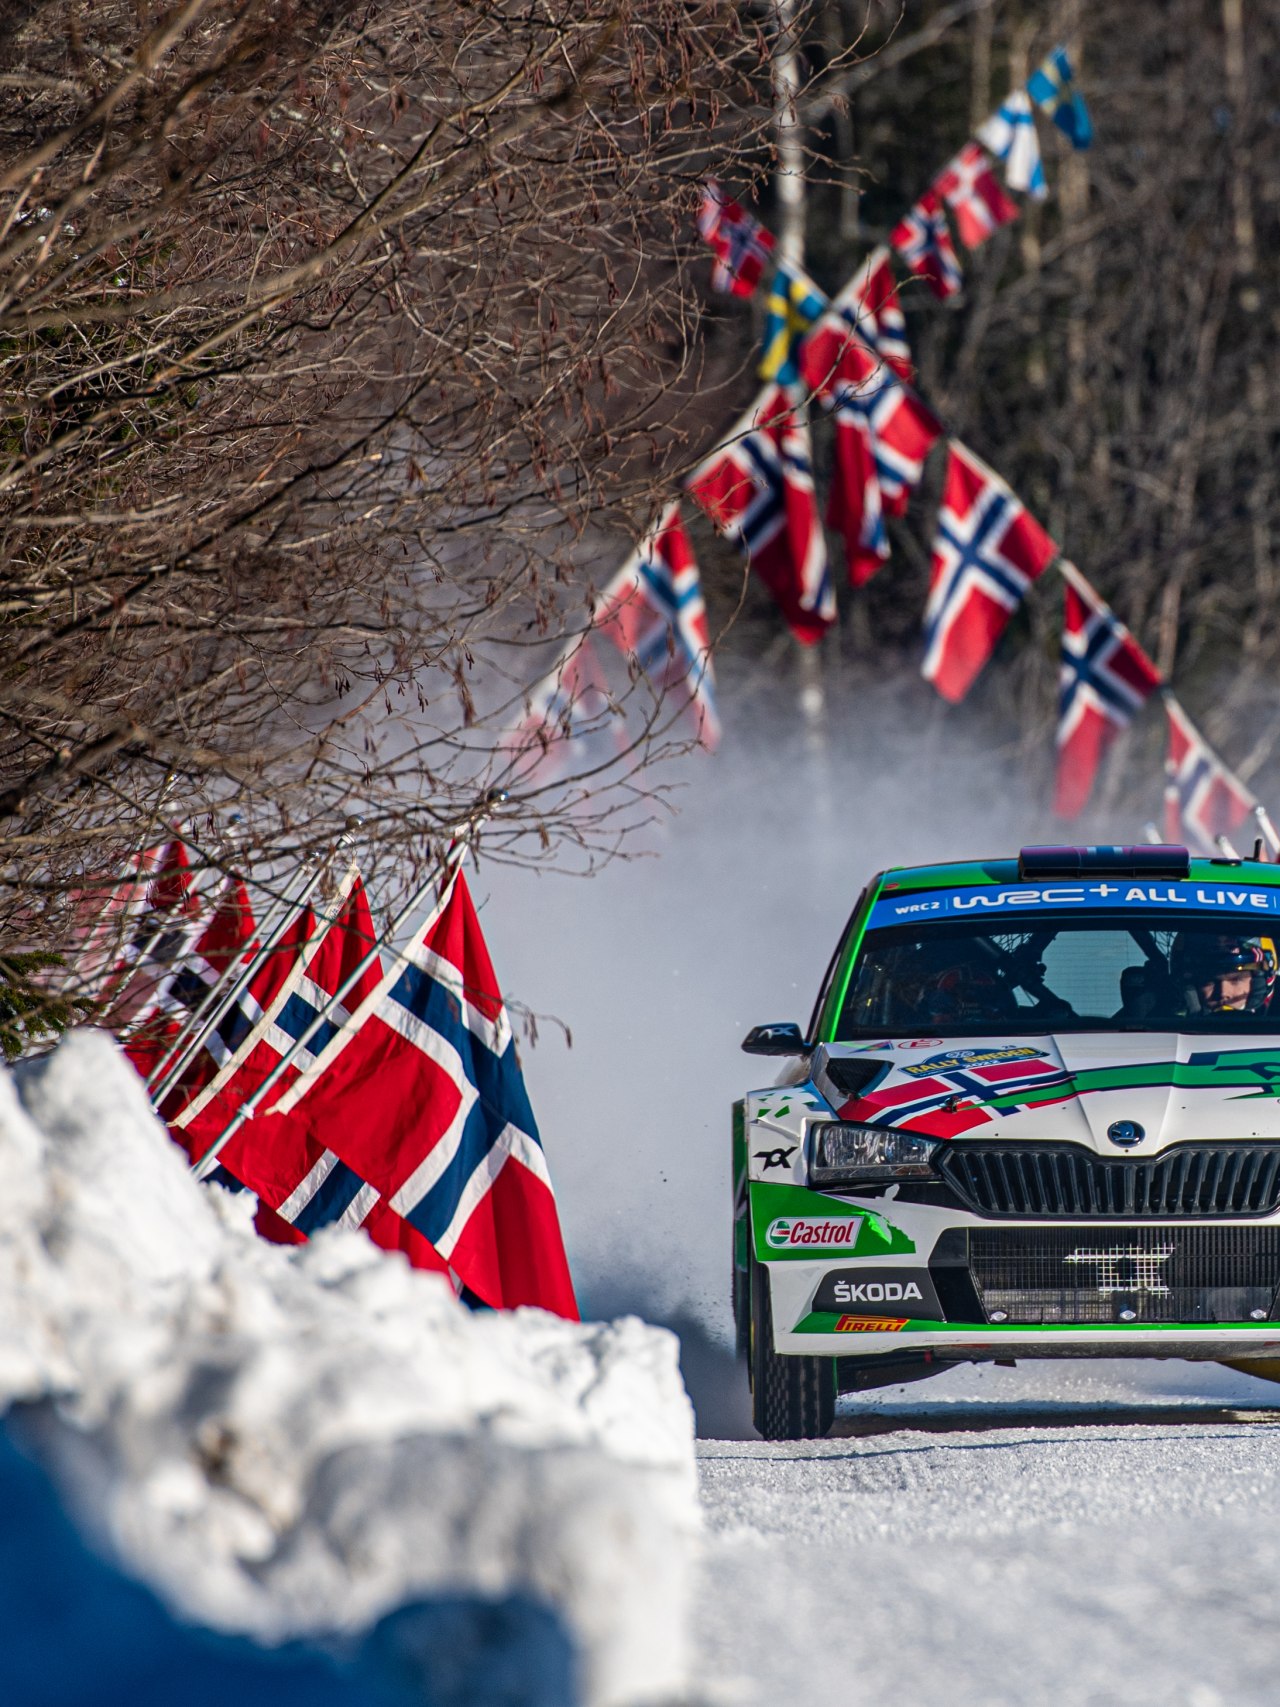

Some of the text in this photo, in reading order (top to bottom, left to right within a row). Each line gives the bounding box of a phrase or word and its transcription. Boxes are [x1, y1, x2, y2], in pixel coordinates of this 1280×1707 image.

[1125, 888, 1187, 902] ALL
[1196, 890, 1269, 908] LIVE
[905, 1058, 960, 1074] RALLY
[963, 1047, 1036, 1063] SWEDEN
[790, 1221, 855, 1244] Castrol
[833, 1280, 923, 1303] ŠKODA
[835, 1314, 910, 1332] PIRELLI
